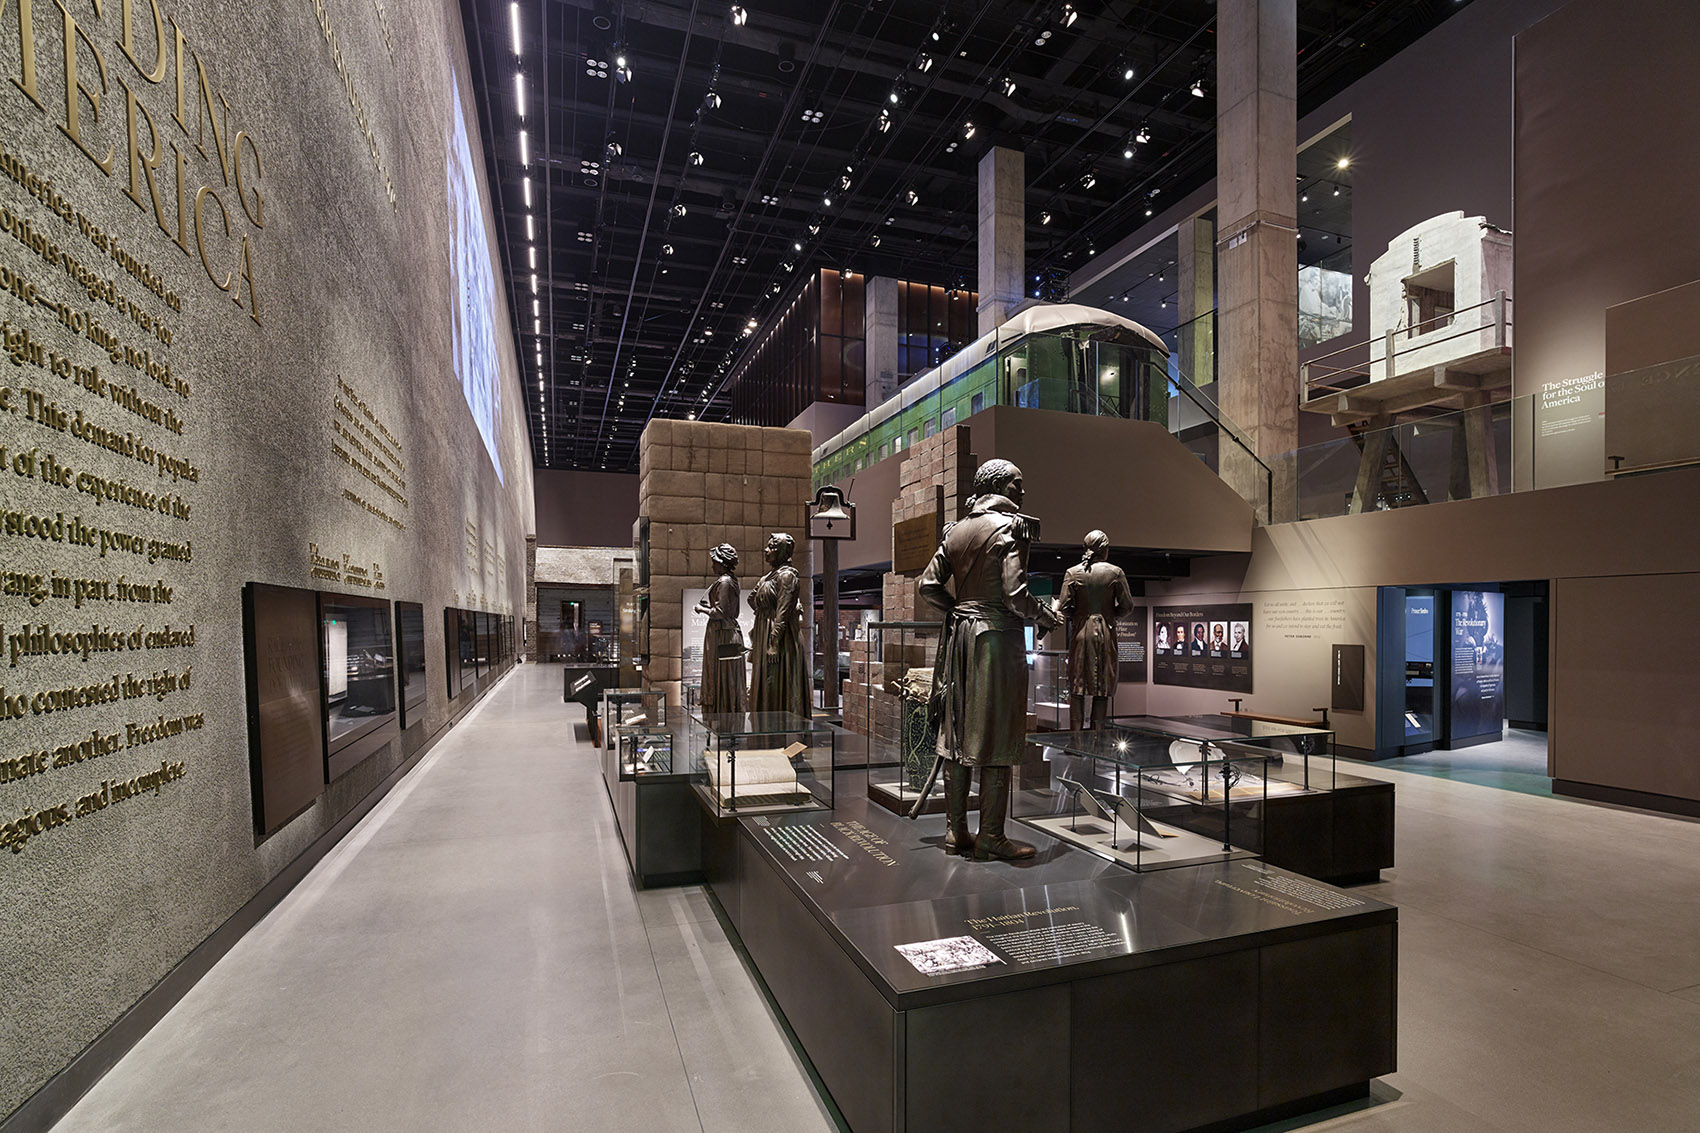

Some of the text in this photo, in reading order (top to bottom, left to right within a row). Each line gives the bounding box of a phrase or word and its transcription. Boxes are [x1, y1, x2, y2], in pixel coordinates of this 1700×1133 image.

[91, 0, 263, 229] DING
[0, 148, 182, 314] merica was founded on
[62, 252, 116, 305] waged
[117, 294, 127, 314] a
[129, 302, 153, 333] war
[154, 316, 174, 348] for
[50, 350, 72, 379] to
[74, 365, 108, 398] rule
[109, 383, 163, 426] without
[163, 408, 185, 436] the
[124, 345, 144, 370] no
[174, 377, 191, 399] no
[1541, 371, 1604, 392] The Struggle
[1542, 391, 1557, 401] for
[1557, 387, 1574, 397] the
[1574, 380, 1597, 393] Soul
[1540, 396, 1581, 410] America
[21, 387, 69, 432] This
[71, 410, 134, 458] demand
[135, 436, 157, 465] for
[157, 451, 200, 483] popular
[13, 447, 38, 479] of
[40, 454, 74, 488] the
[76, 470, 157, 511] experience
[158, 492, 172, 516] of
[172, 495, 191, 521] the
[67, 515, 98, 548] the
[100, 529, 146, 558] power
[148, 538, 193, 564] granted
[51, 568, 71, 600] in
[116, 574, 151, 603] from
[152, 579, 173, 604] the
[8, 622, 125, 667] philosophies
[127, 623, 145, 650] of
[145, 624, 195, 649] enslaved
[31, 673, 120, 715] contested
[121, 671, 146, 701] the
[147, 668, 176, 702] right
[178, 665, 192, 691] of
[51, 729, 124, 770] another.
[125, 715, 182, 749] Freedom
[183, 712, 205, 733] was
[75, 780, 109, 819] and
[986, 912, 1024, 922] Haitian
